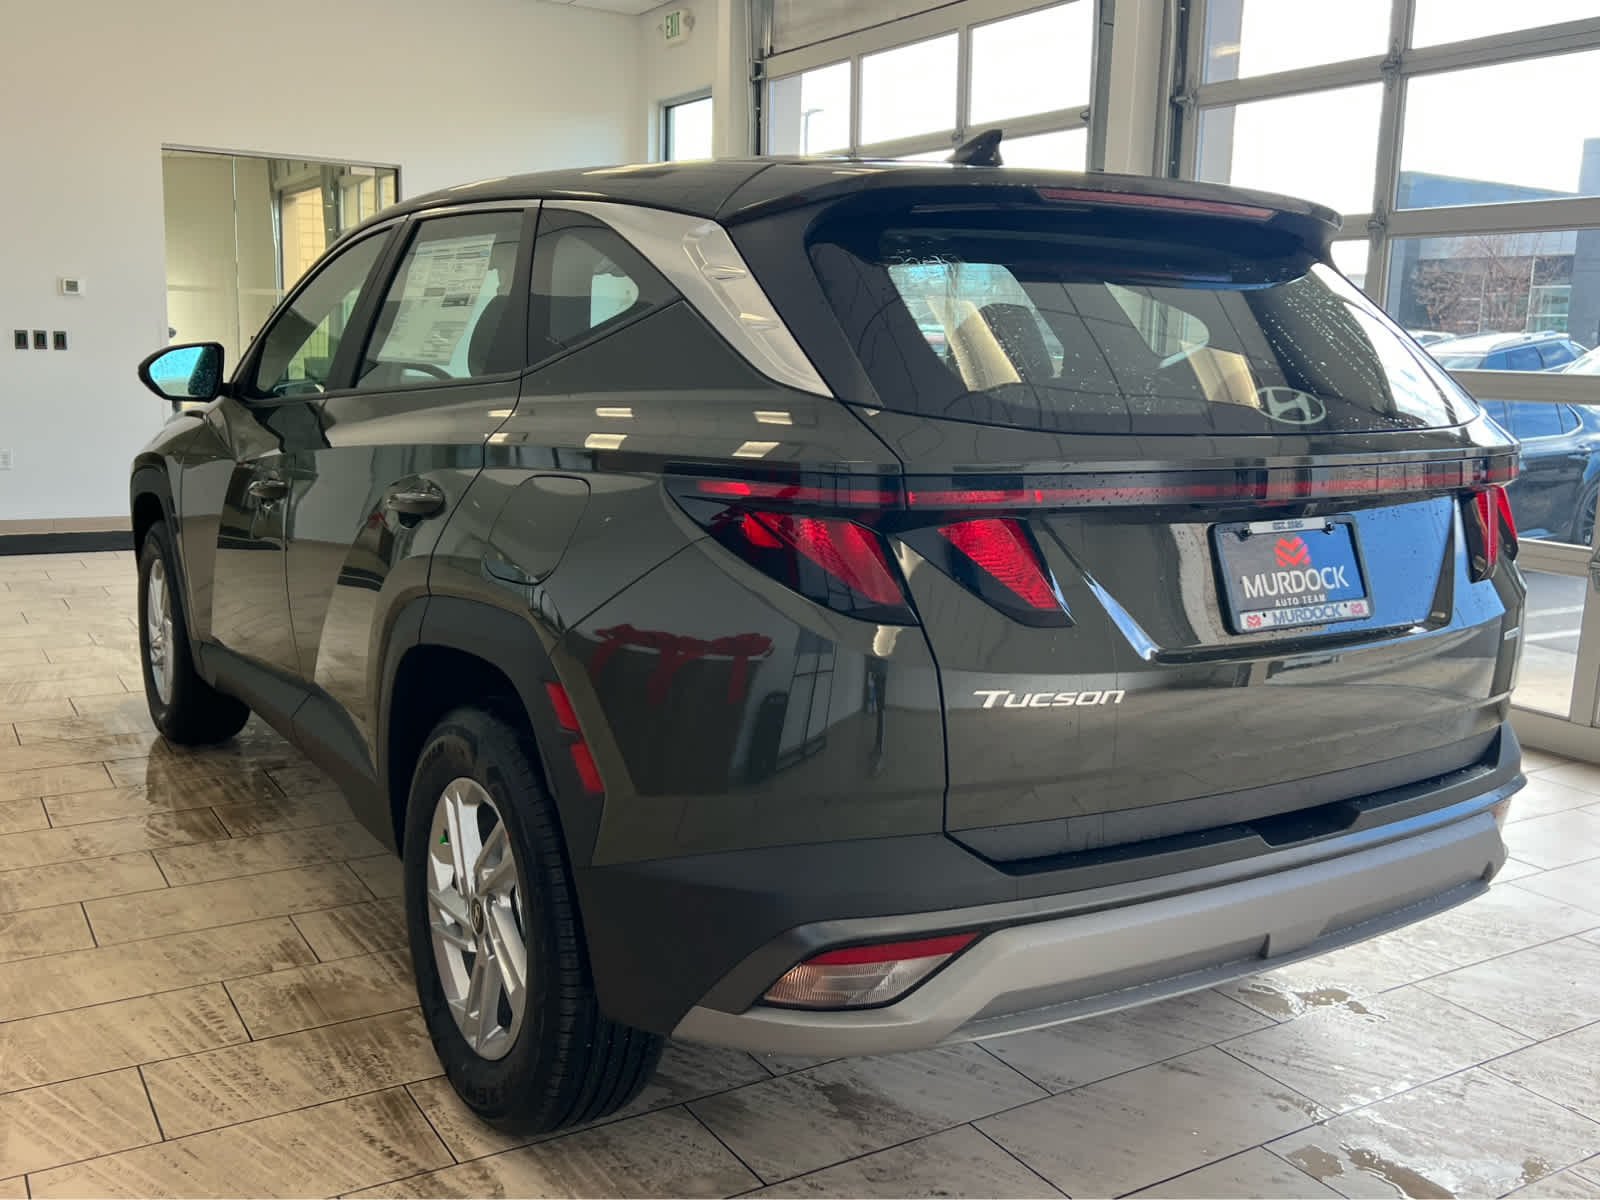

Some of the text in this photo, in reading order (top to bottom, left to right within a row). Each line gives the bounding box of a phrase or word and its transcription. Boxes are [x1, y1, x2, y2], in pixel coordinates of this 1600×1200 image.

[666, 11, 680, 40] EXIT
[1242, 565, 1349, 599] MURDOCK
[1275, 594, 1327, 607] AUTO TEAM
[1273, 604, 1342, 625] MURDOCK
